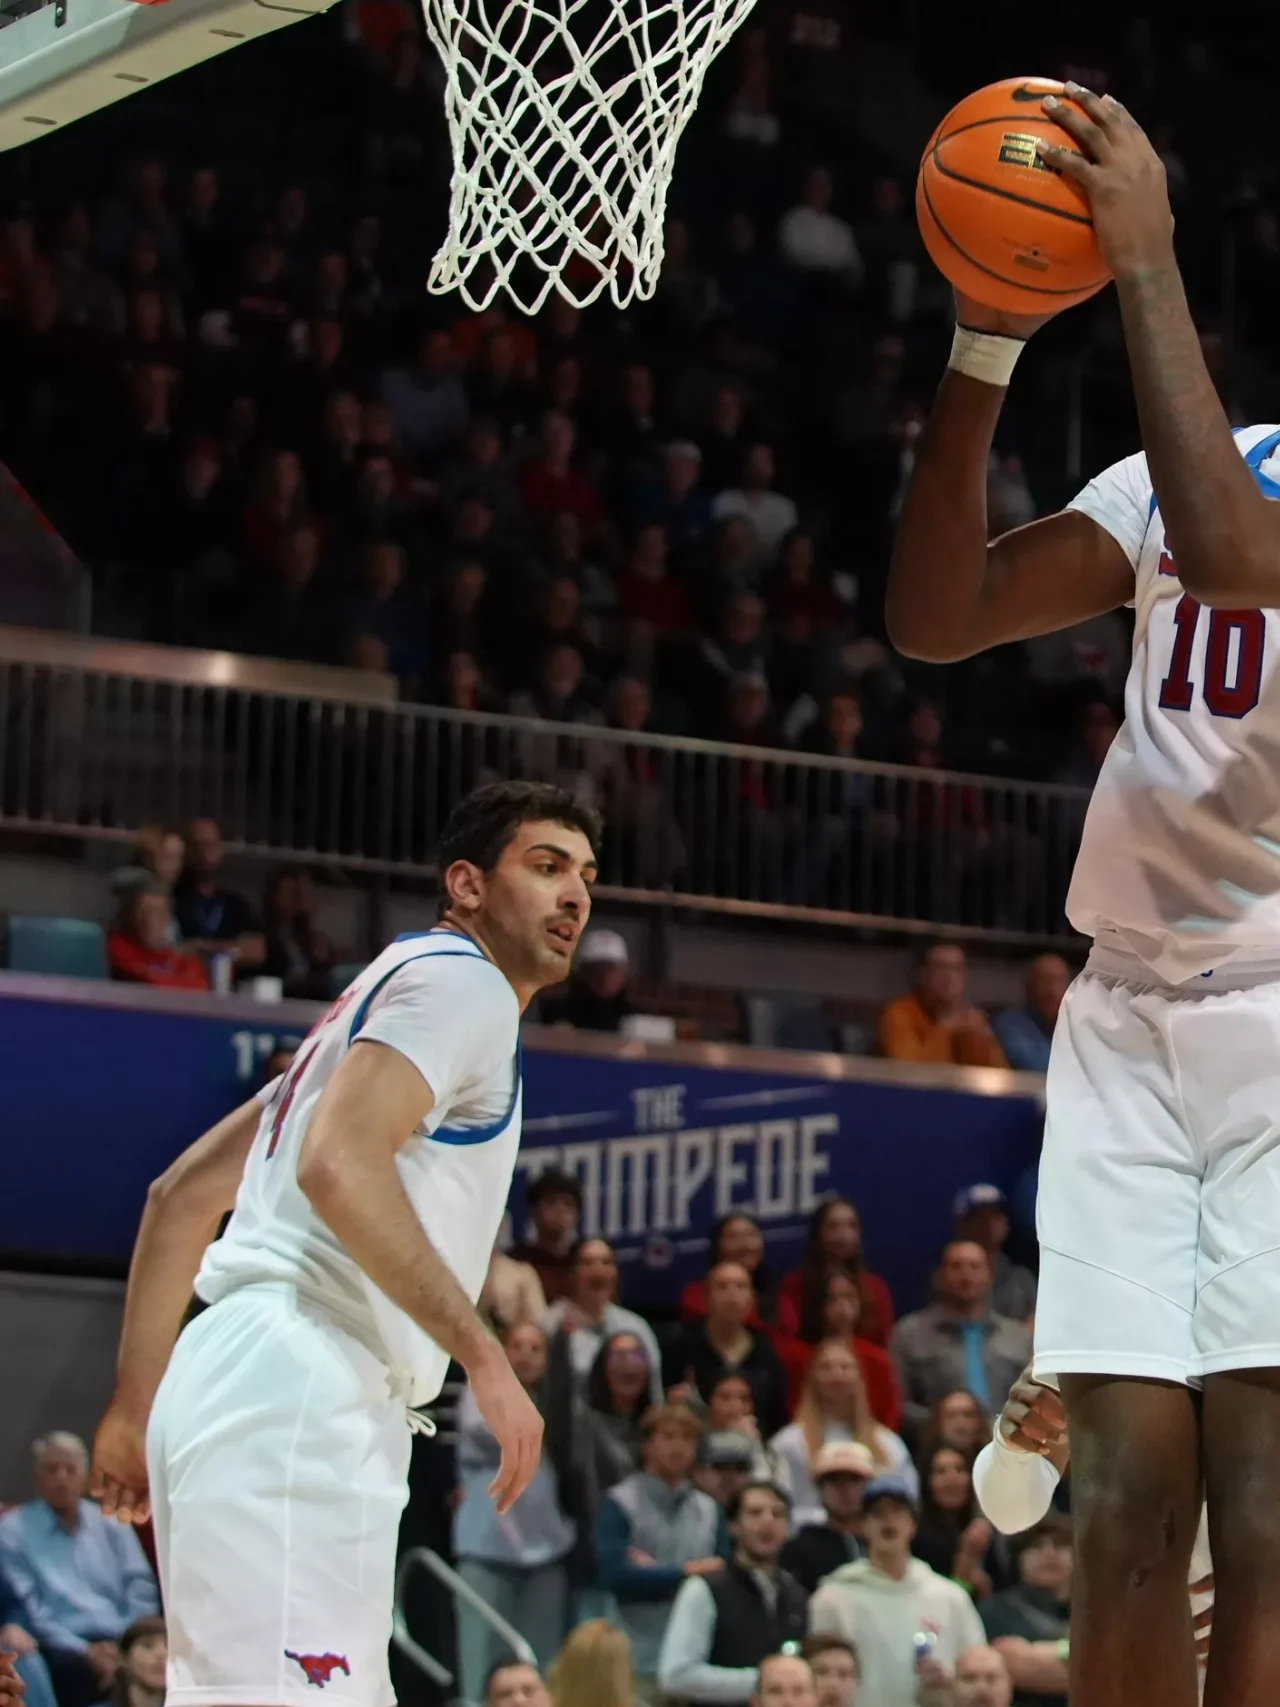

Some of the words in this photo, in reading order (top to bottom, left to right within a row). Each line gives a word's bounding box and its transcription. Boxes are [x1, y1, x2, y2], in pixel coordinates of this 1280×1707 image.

[1158, 592, 1267, 720] 10
[630, 1083, 688, 1132] THE
[505, 1112, 841, 1246] TAMPEDE
